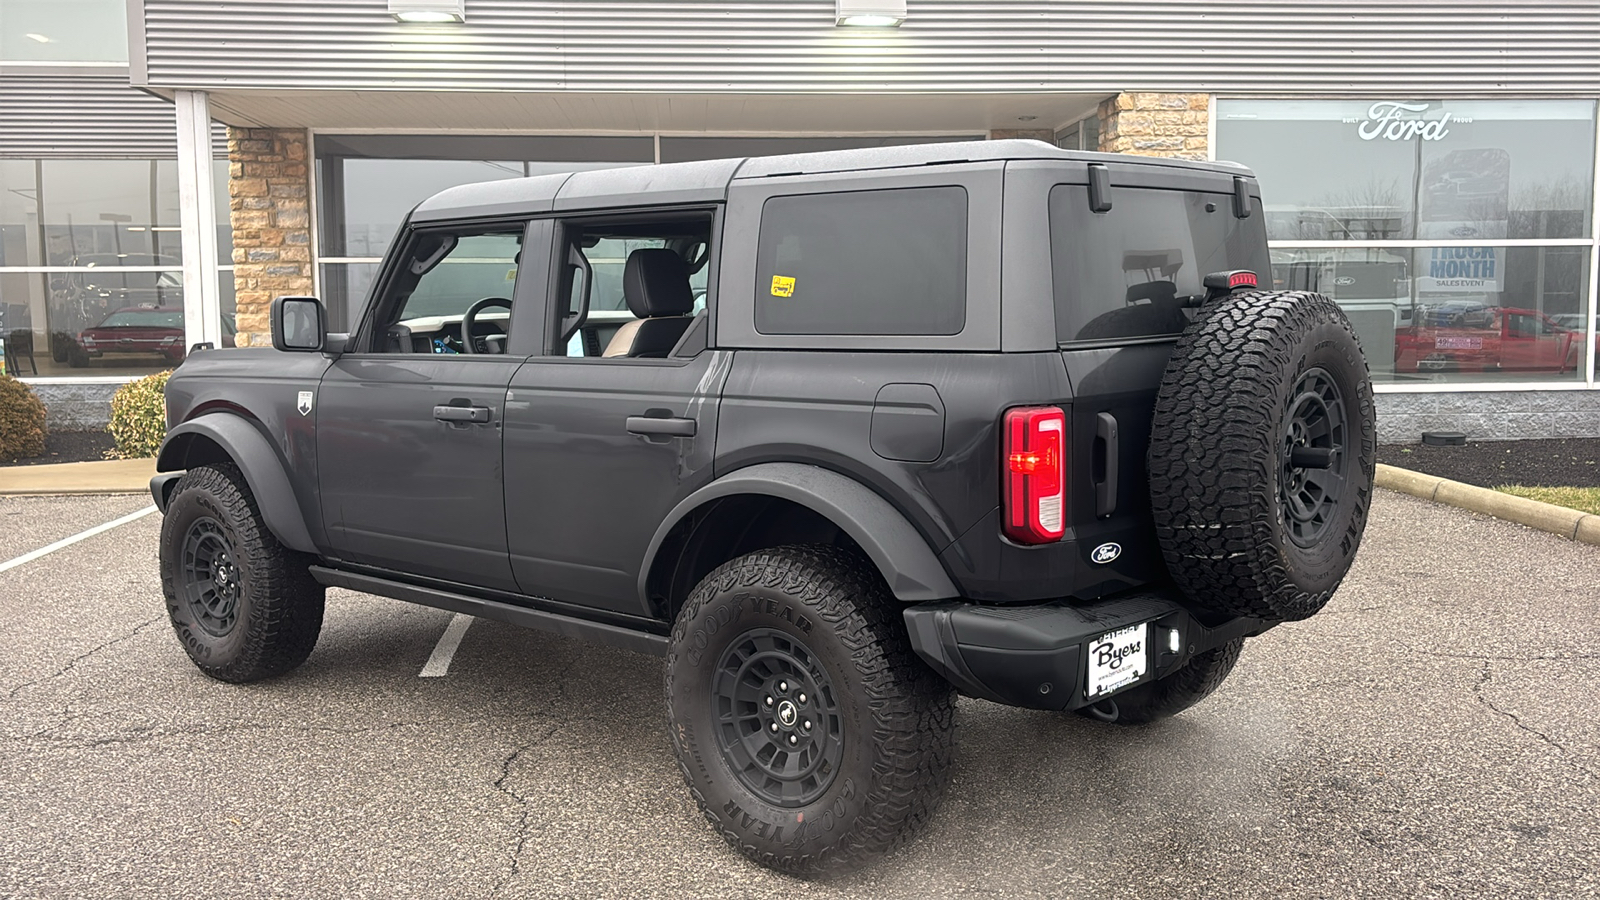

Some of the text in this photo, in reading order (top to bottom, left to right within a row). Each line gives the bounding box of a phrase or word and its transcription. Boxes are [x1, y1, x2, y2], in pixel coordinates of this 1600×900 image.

[1358, 101, 1452, 140] Ford
[1430, 260, 1496, 278] MONTH
[1091, 641, 1141, 669] Byers
